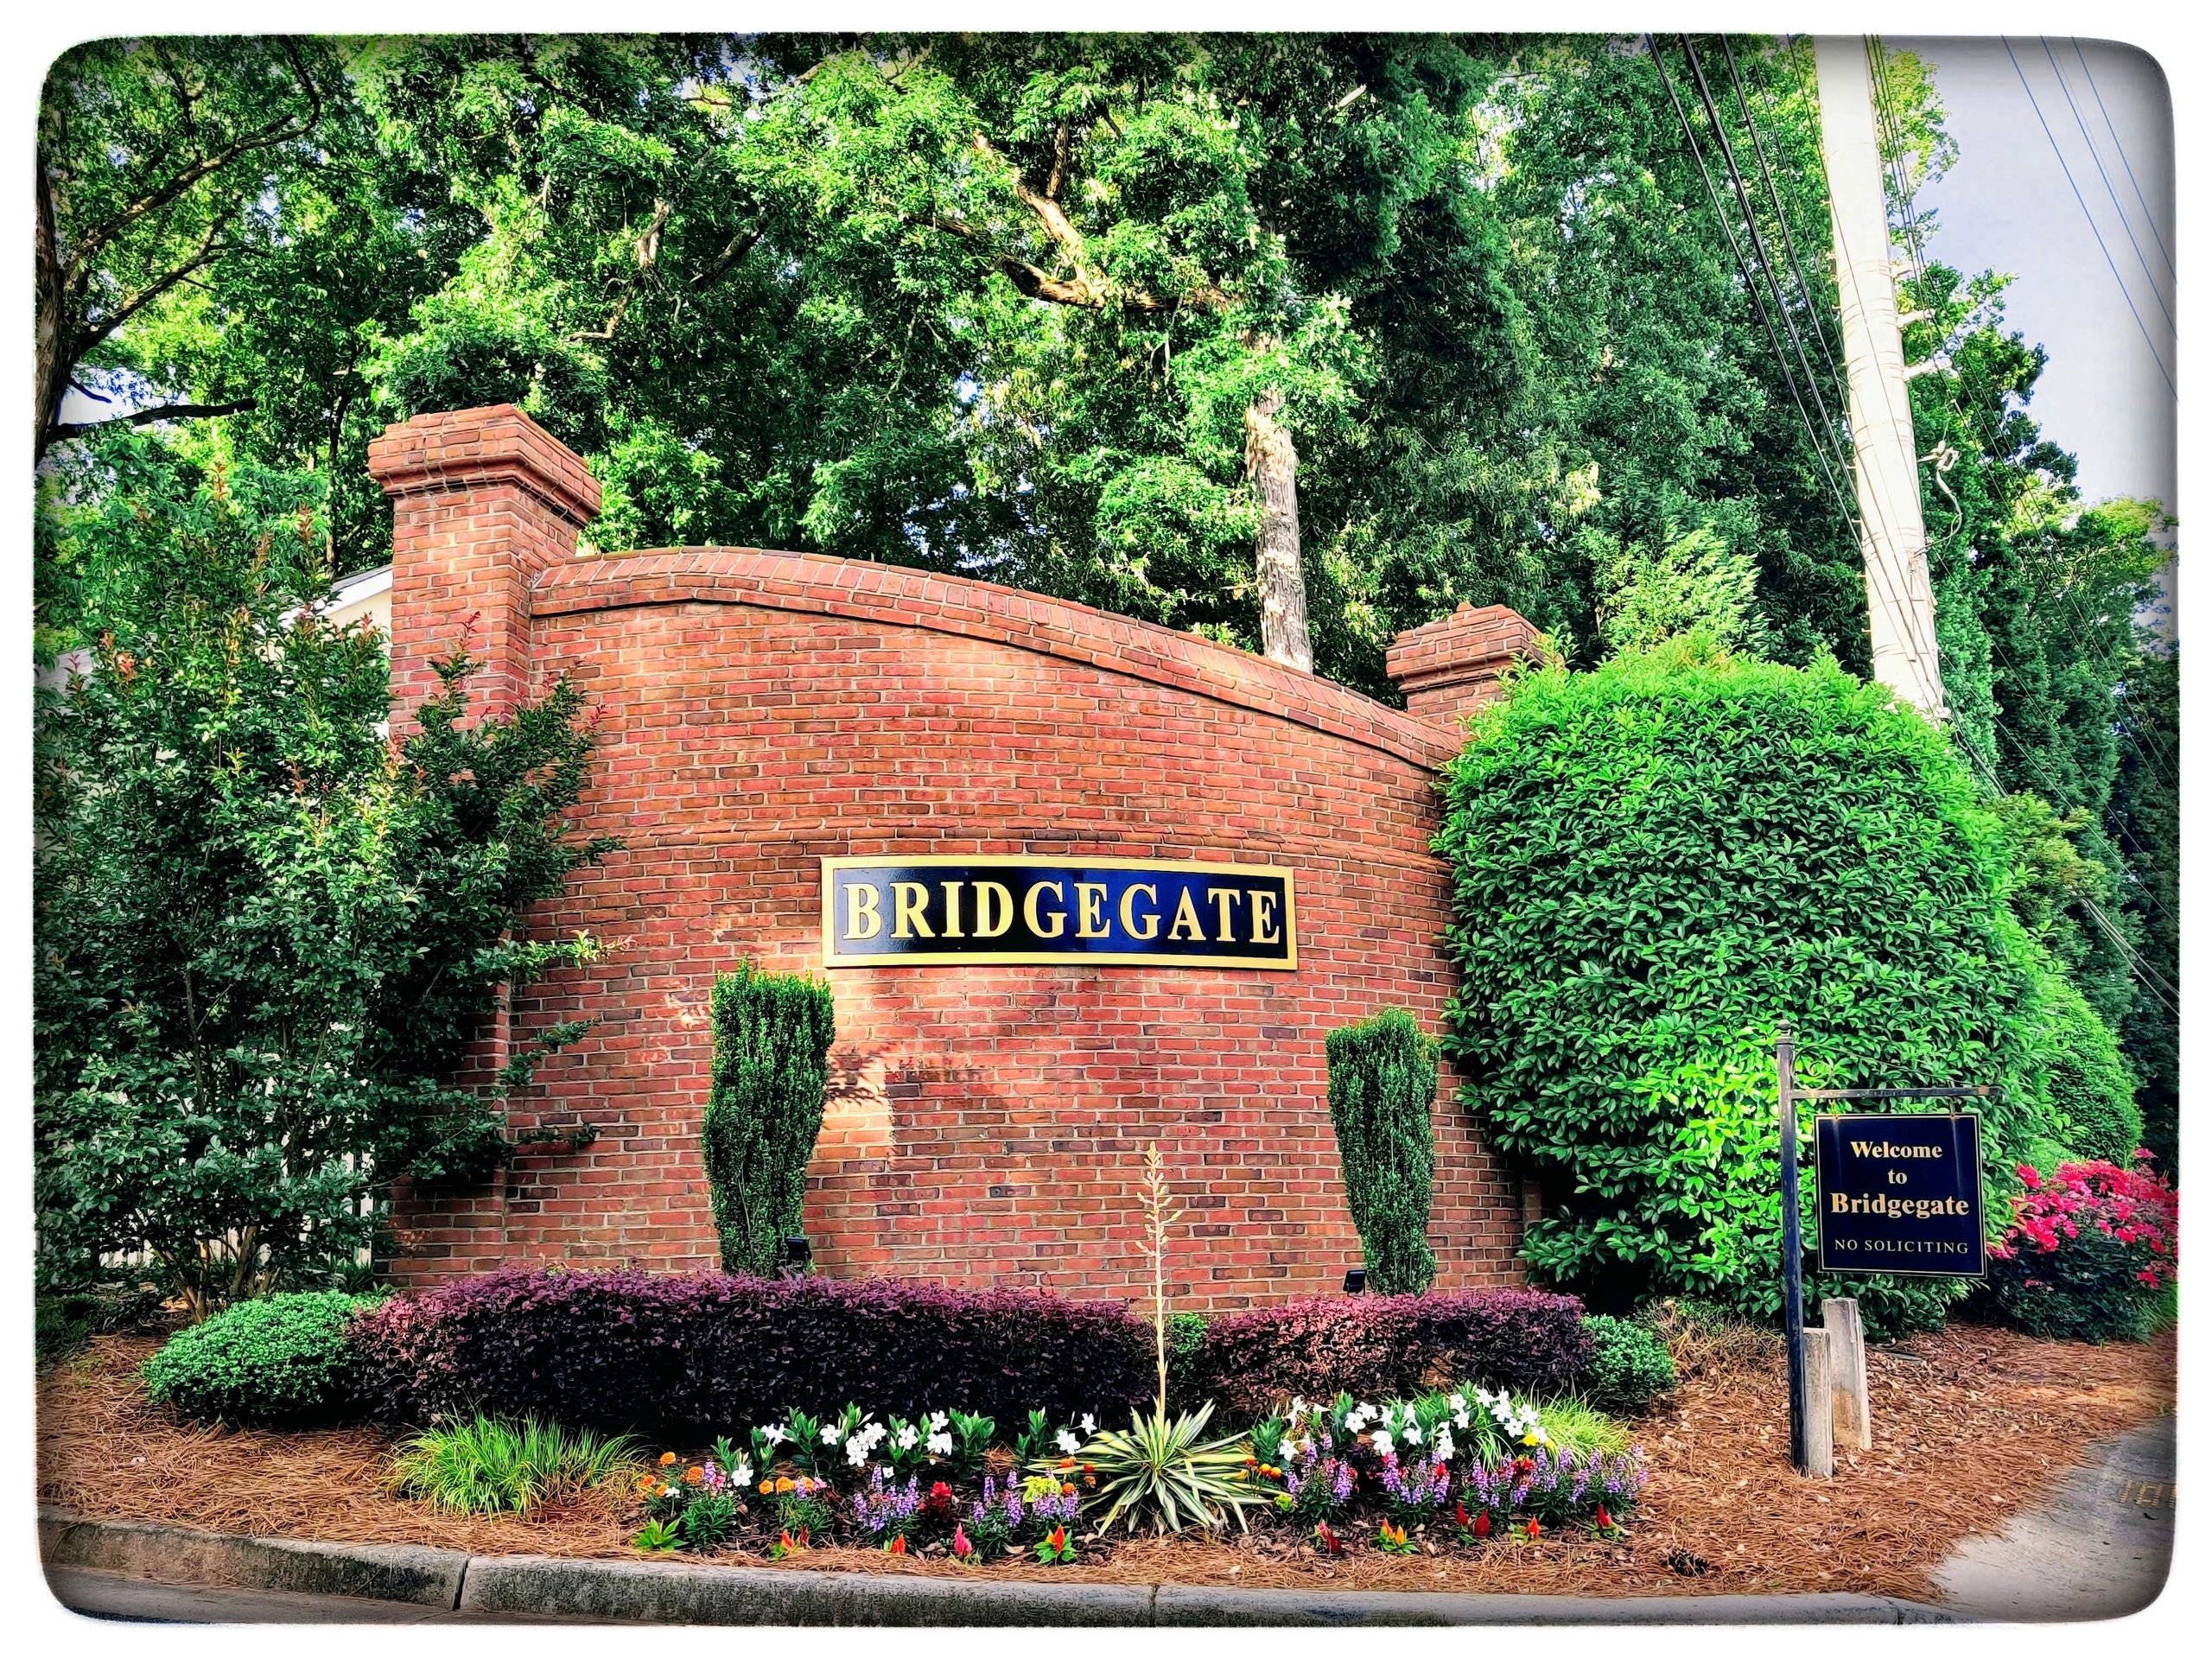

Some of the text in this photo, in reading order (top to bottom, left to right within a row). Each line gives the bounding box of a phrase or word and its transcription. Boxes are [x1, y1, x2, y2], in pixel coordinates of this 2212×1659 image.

[842, 880, 1280, 944] BRIDGEGATE
[1850, 1141, 1943, 1159] Welcome
[1887, 1168, 1908, 1185] to
[1829, 1192, 1970, 1219] Bridgegate
[1834, 1239, 1968, 1254] NO SOLICITING
